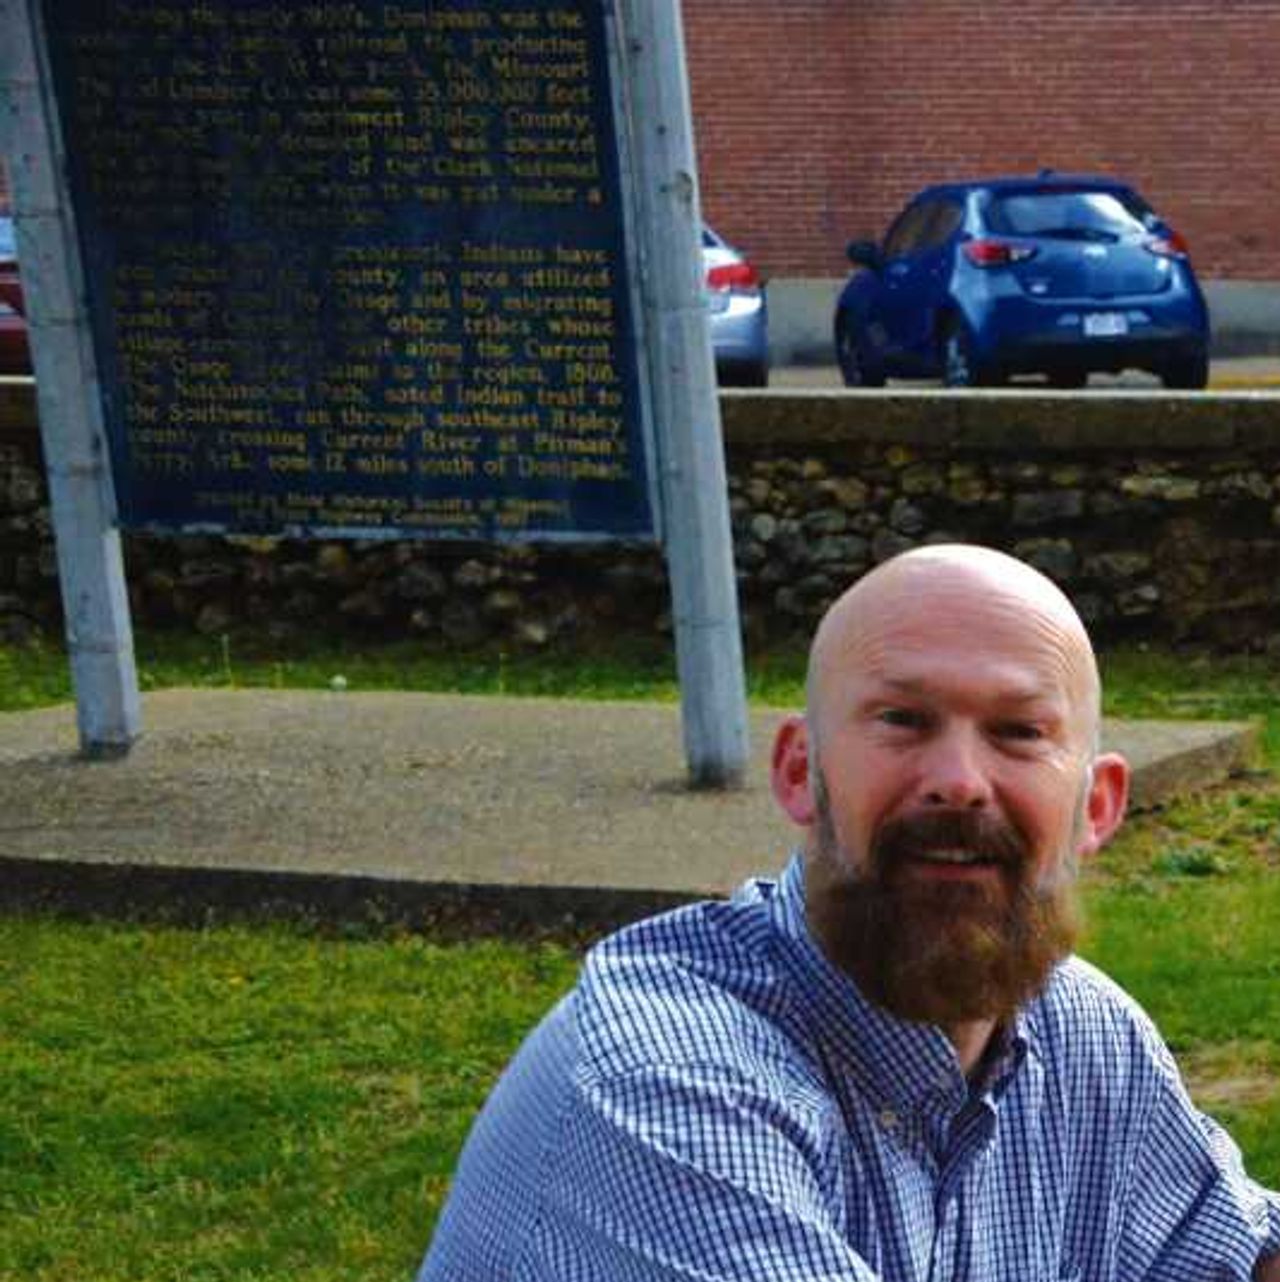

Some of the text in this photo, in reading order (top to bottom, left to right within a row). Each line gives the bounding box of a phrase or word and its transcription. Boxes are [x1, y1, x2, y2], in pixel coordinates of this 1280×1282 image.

[500, 11, 539, 28] was
[546, 9, 586, 28] the
[472, 33, 587, 59] producing
[490, 56, 589, 79] Missouri
[545, 82, 593, 104] feet
[588, 185, 601, 204] a
[555, 242, 610, 264] have
[459, 270, 509, 288] area
[521, 267, 611, 288] utilized
[411, 291, 452, 310] and
[461, 291, 489, 313] by
[502, 294, 613, 318] migrating
[386, 312, 448, 334] other
[463, 313, 532, 335] tribes
[547, 315, 615, 336] whose
[405, 336, 463, 362] along
[477, 339, 514, 360] the
[384, 383, 444, 405] noted
[457, 384, 525, 406] Indian
[537, 385, 586, 406] trail
[596, 388, 623, 406] to
[340, 406, 426, 432] through
[437, 408, 540, 429] southeast
[550, 409, 622, 434] Ripley
[420, 430, 481, 451] River
[497, 433, 519, 452] at
[324, 451, 346, 473] 12
[355, 453, 408, 475] miles
[416, 454, 475, 476] south
[482, 455, 506, 475] of
